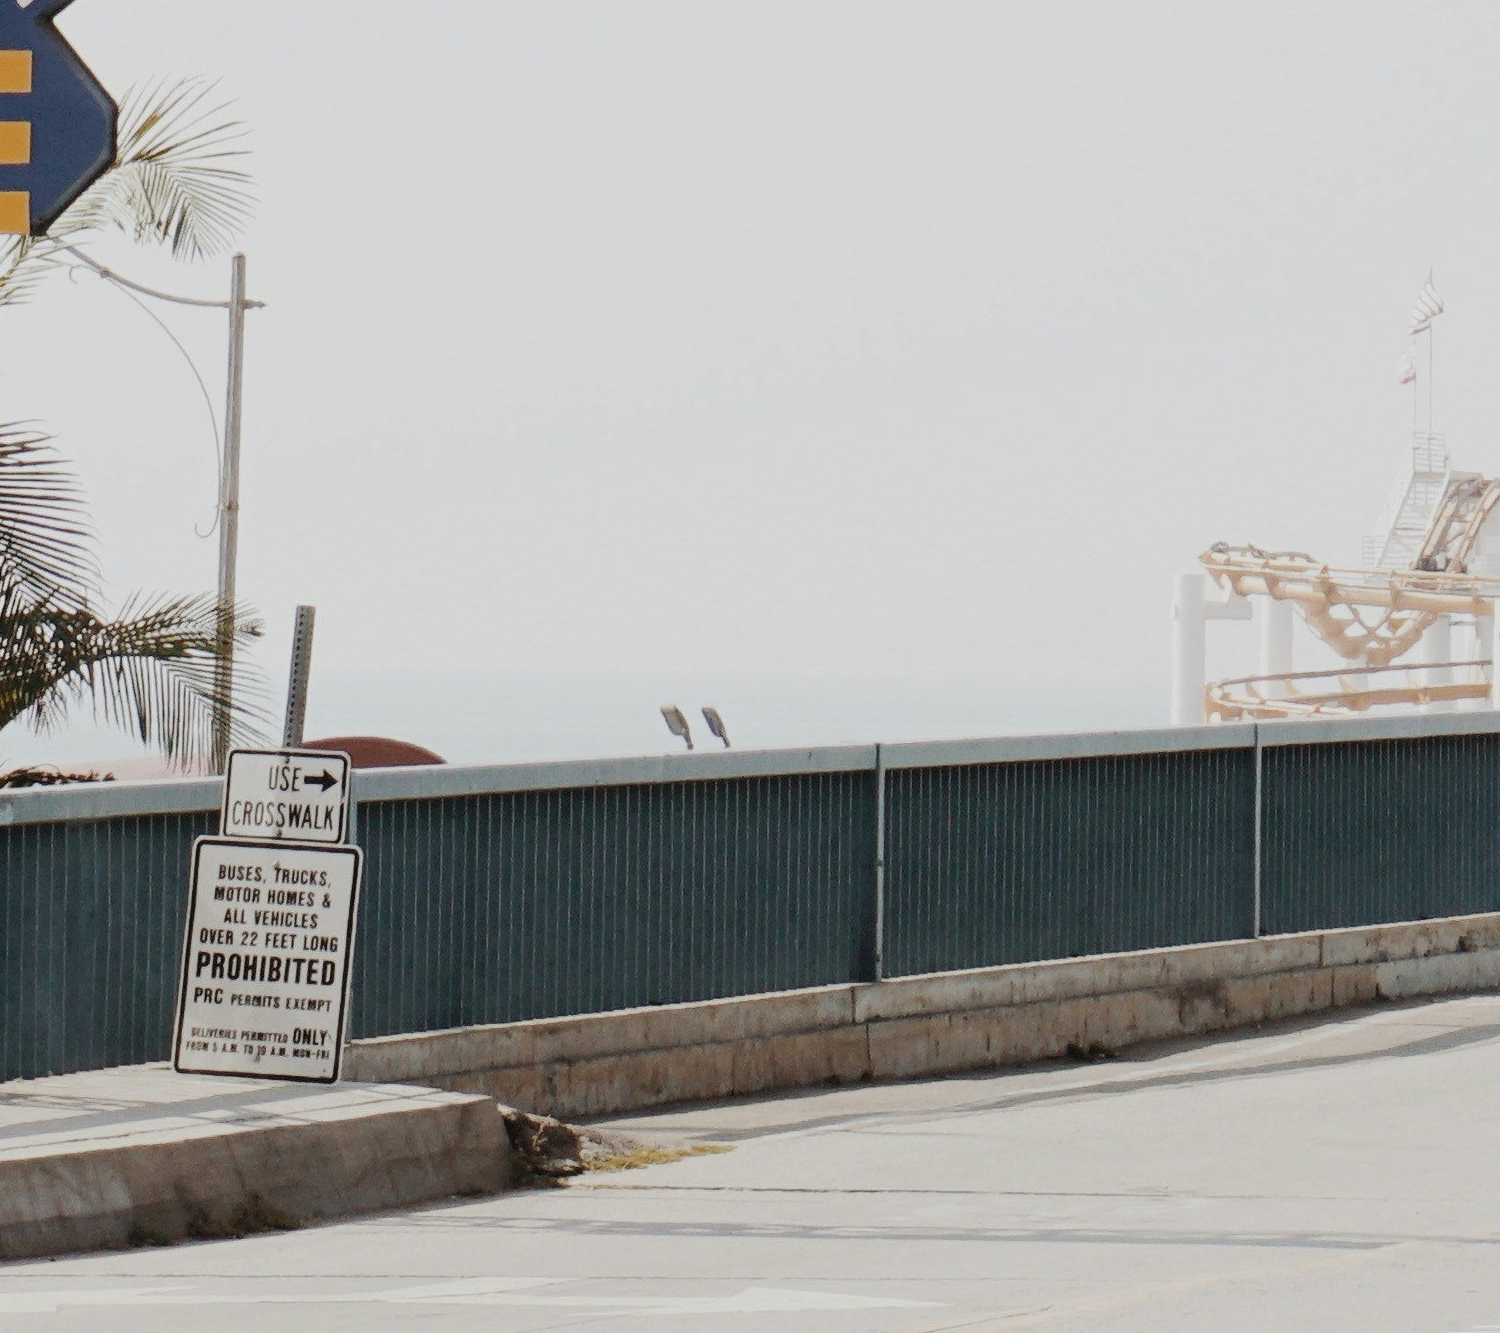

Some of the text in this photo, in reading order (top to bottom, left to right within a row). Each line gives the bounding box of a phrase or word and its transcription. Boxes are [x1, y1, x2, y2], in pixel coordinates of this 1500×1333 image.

[269, 765, 301, 792] USE
[232, 800, 335, 831] CROSSWALK
[218, 864, 332, 889] BUSES, TRUCKS,
[213, 886, 332, 909] MOTOR HOMES &
[223, 908, 319, 929] ALL VEHICLES
[200, 927, 339, 953] OVER 22 FEET LONG
[195, 950, 336, 986] PROHIBITED
[193, 986, 333, 1013] PRC PERMITS EXEMPT
[185, 1040, 209, 1052] FROM
[243, 1044, 254, 1056] TO
[191, 1026, 329, 1046] DELIVERIES PERMITTED ONLY
